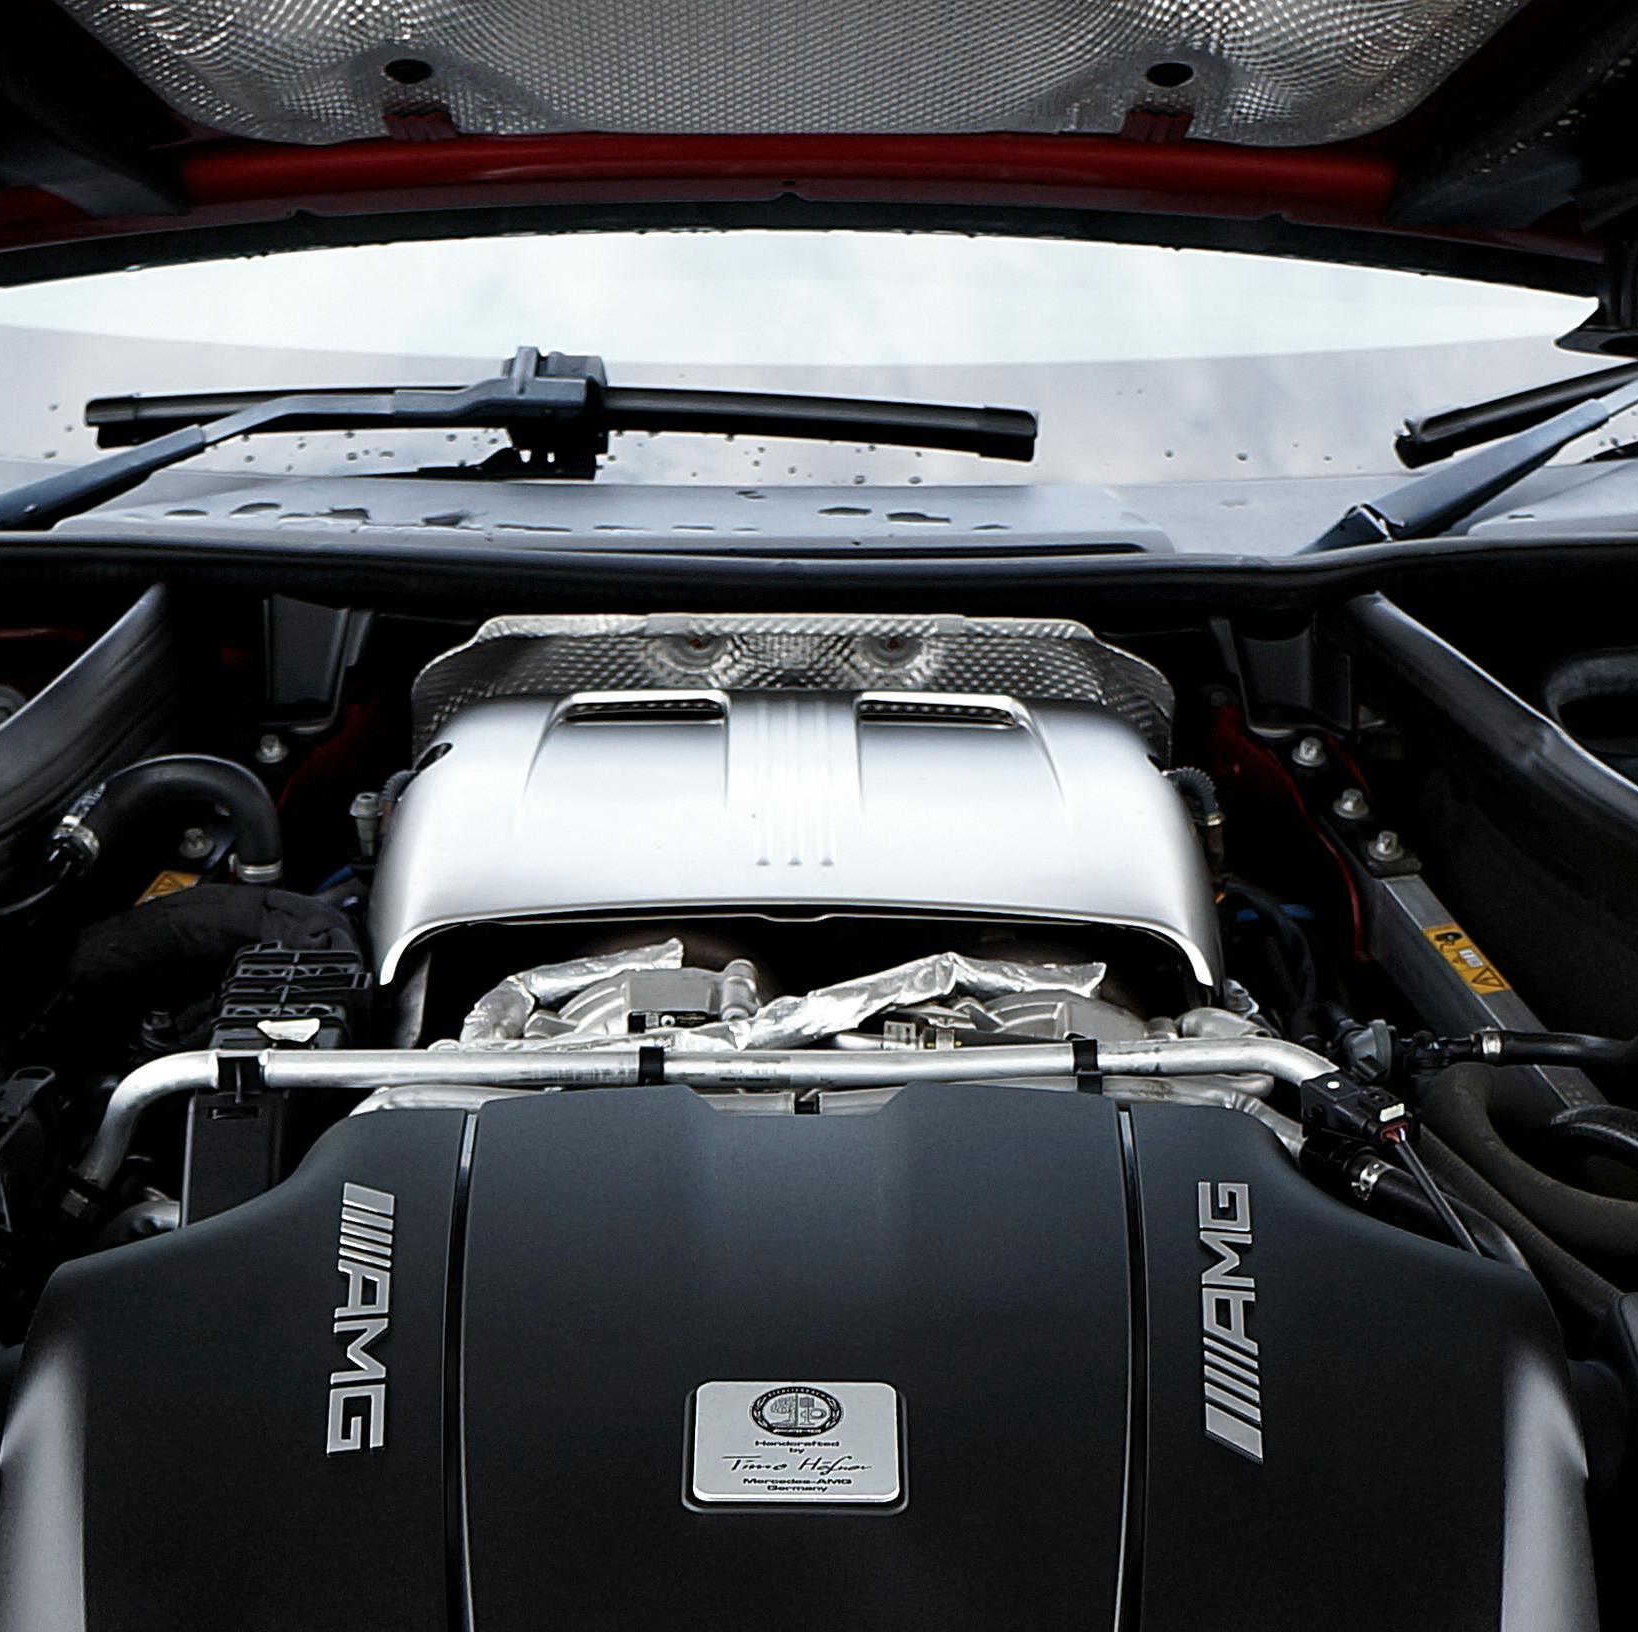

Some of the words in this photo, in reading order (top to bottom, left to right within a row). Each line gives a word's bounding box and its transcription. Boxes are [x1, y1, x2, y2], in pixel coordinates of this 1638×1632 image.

[1198, 1181, 1259, 1356] AMG
[327, 1259, 391, 1454] AMG
[766, 1485, 828, 1493] Germany
